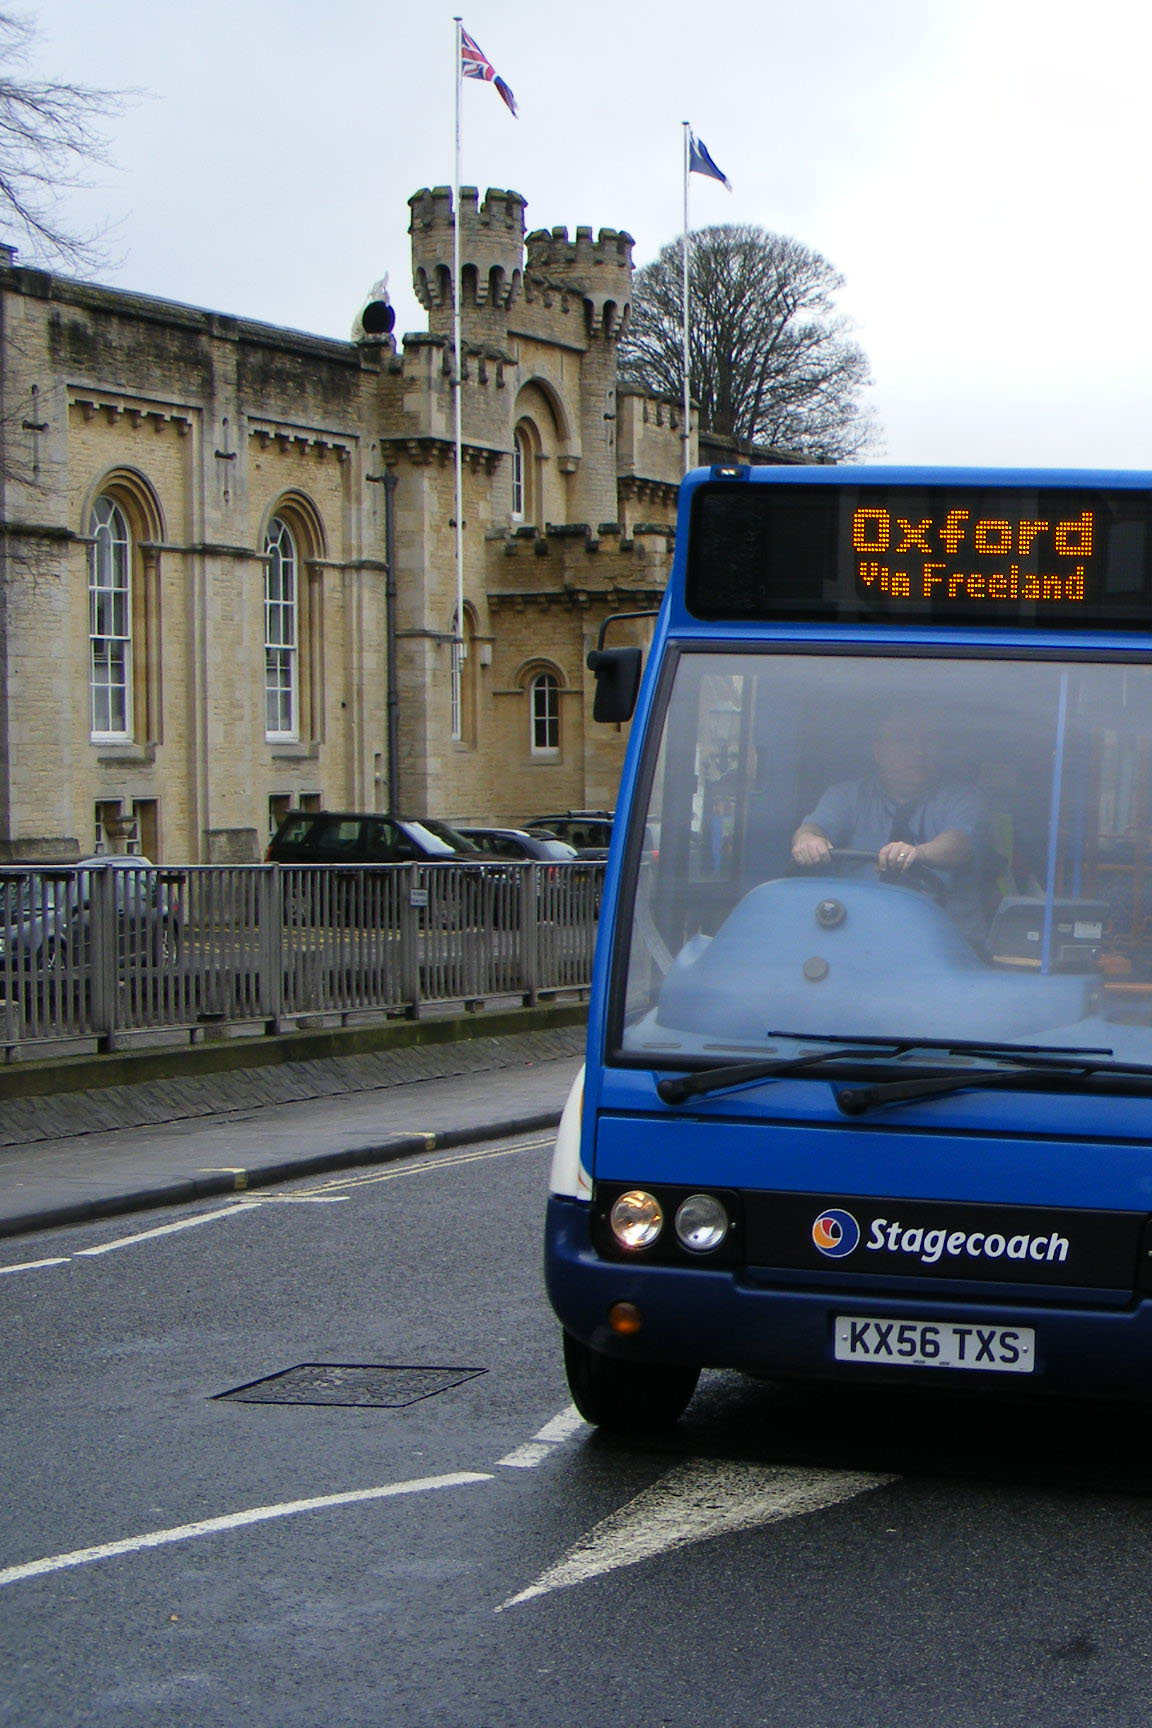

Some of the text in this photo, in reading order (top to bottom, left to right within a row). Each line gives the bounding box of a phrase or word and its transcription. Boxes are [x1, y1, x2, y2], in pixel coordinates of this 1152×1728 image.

[853, 508, 1093, 556] Oxford
[923, 562, 1084, 600] Freeland
[866, 1218, 1070, 1263] Stagecoach
[850, 1321, 1020, 1364] KX56 TXS
